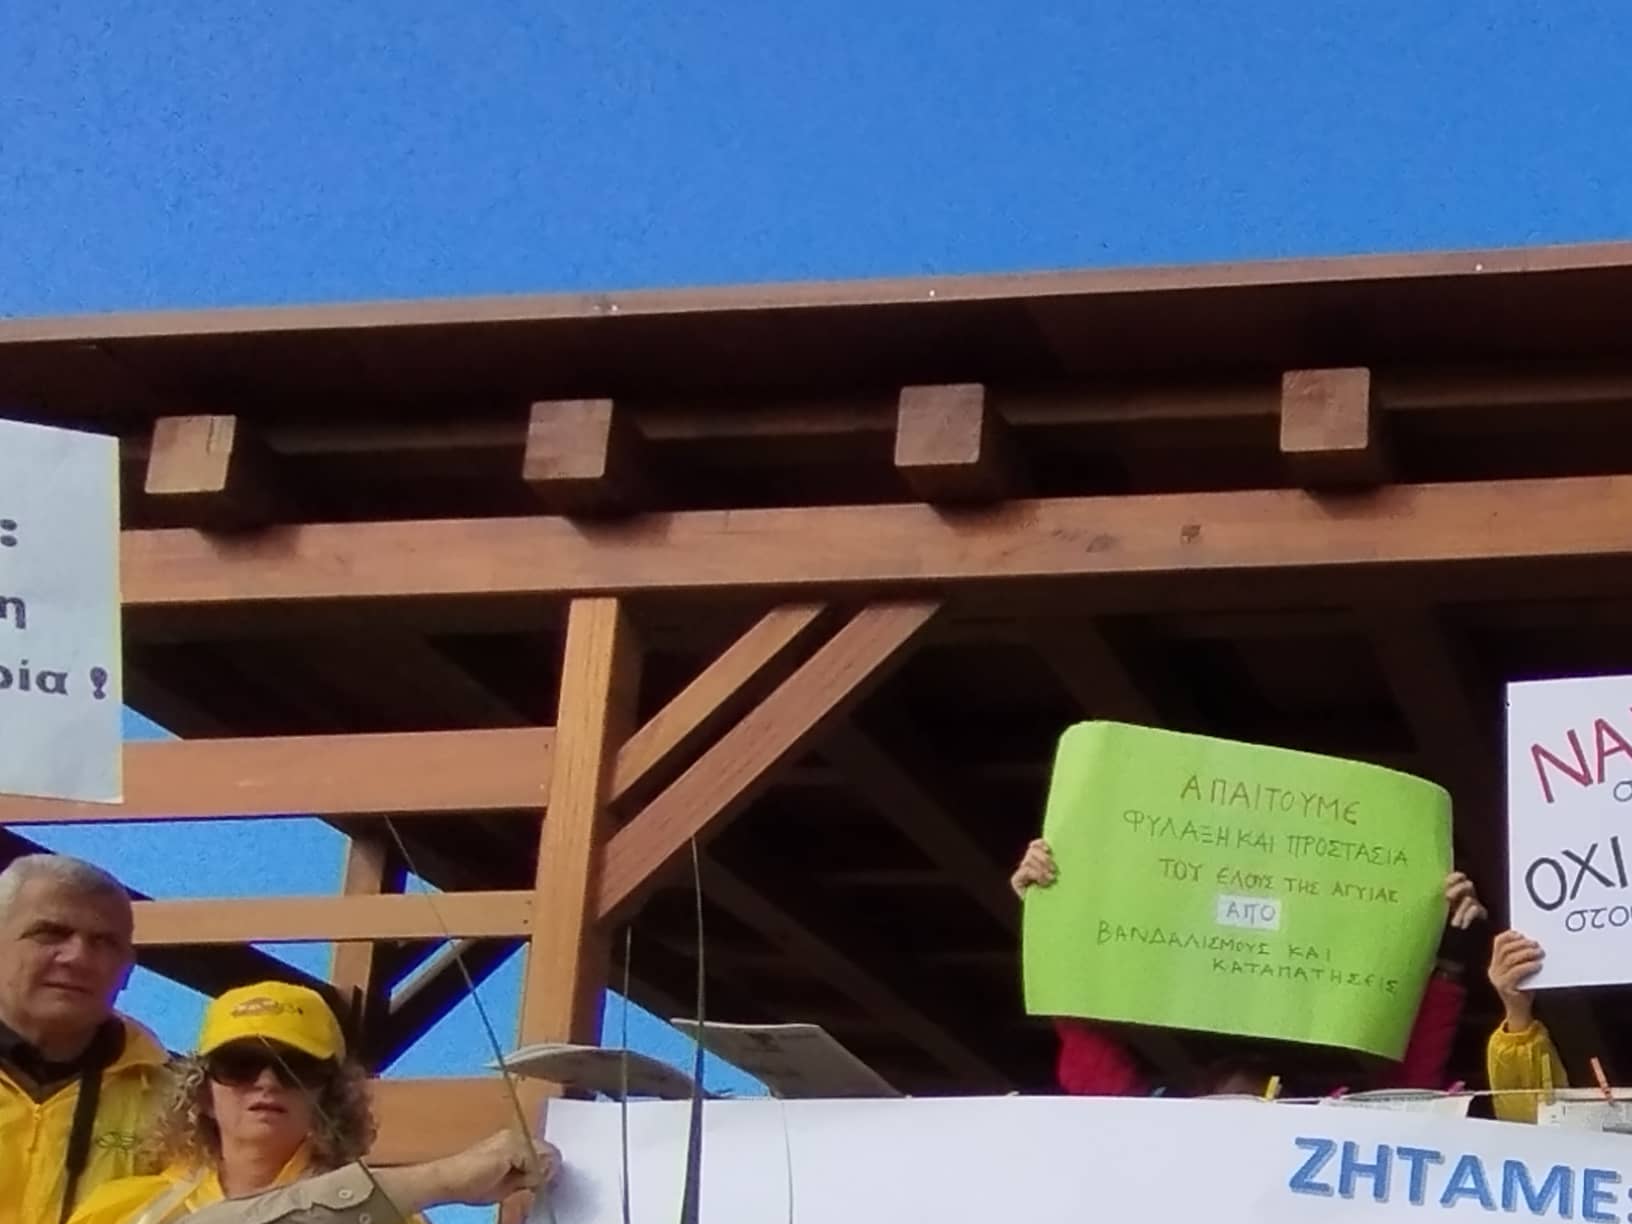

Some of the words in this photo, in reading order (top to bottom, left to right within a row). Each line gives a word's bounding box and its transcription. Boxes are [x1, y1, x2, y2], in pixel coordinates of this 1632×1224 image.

[1180, 775, 1361, 826] ΑΠΑΙΤΟΥΜΕ
[1123, 809, 1231, 848] ΦΥΛΑΞΗ
[1236, 827, 1276, 854] ΚΑΙ
[1286, 834, 1409, 867] ΠΡΟΣΤΑΣΙΑ
[1158, 857, 1203, 883] ΤΟΥ
[1284, 876, 1320, 897] ΤΗΣ
[1524, 835, 1630, 912] ΟΧΙ
[1225, 901, 1277, 926] ΑΠΟ
[1096, 919, 1273, 957] ΒΑΝΔΑΛΙΣΜΟΥΣ
[1287, 944, 1333, 963] ΚΑΙ
[1211, 957, 1400, 994] ΚΑΤΑΠΑΤΗΣΕΙΣ
